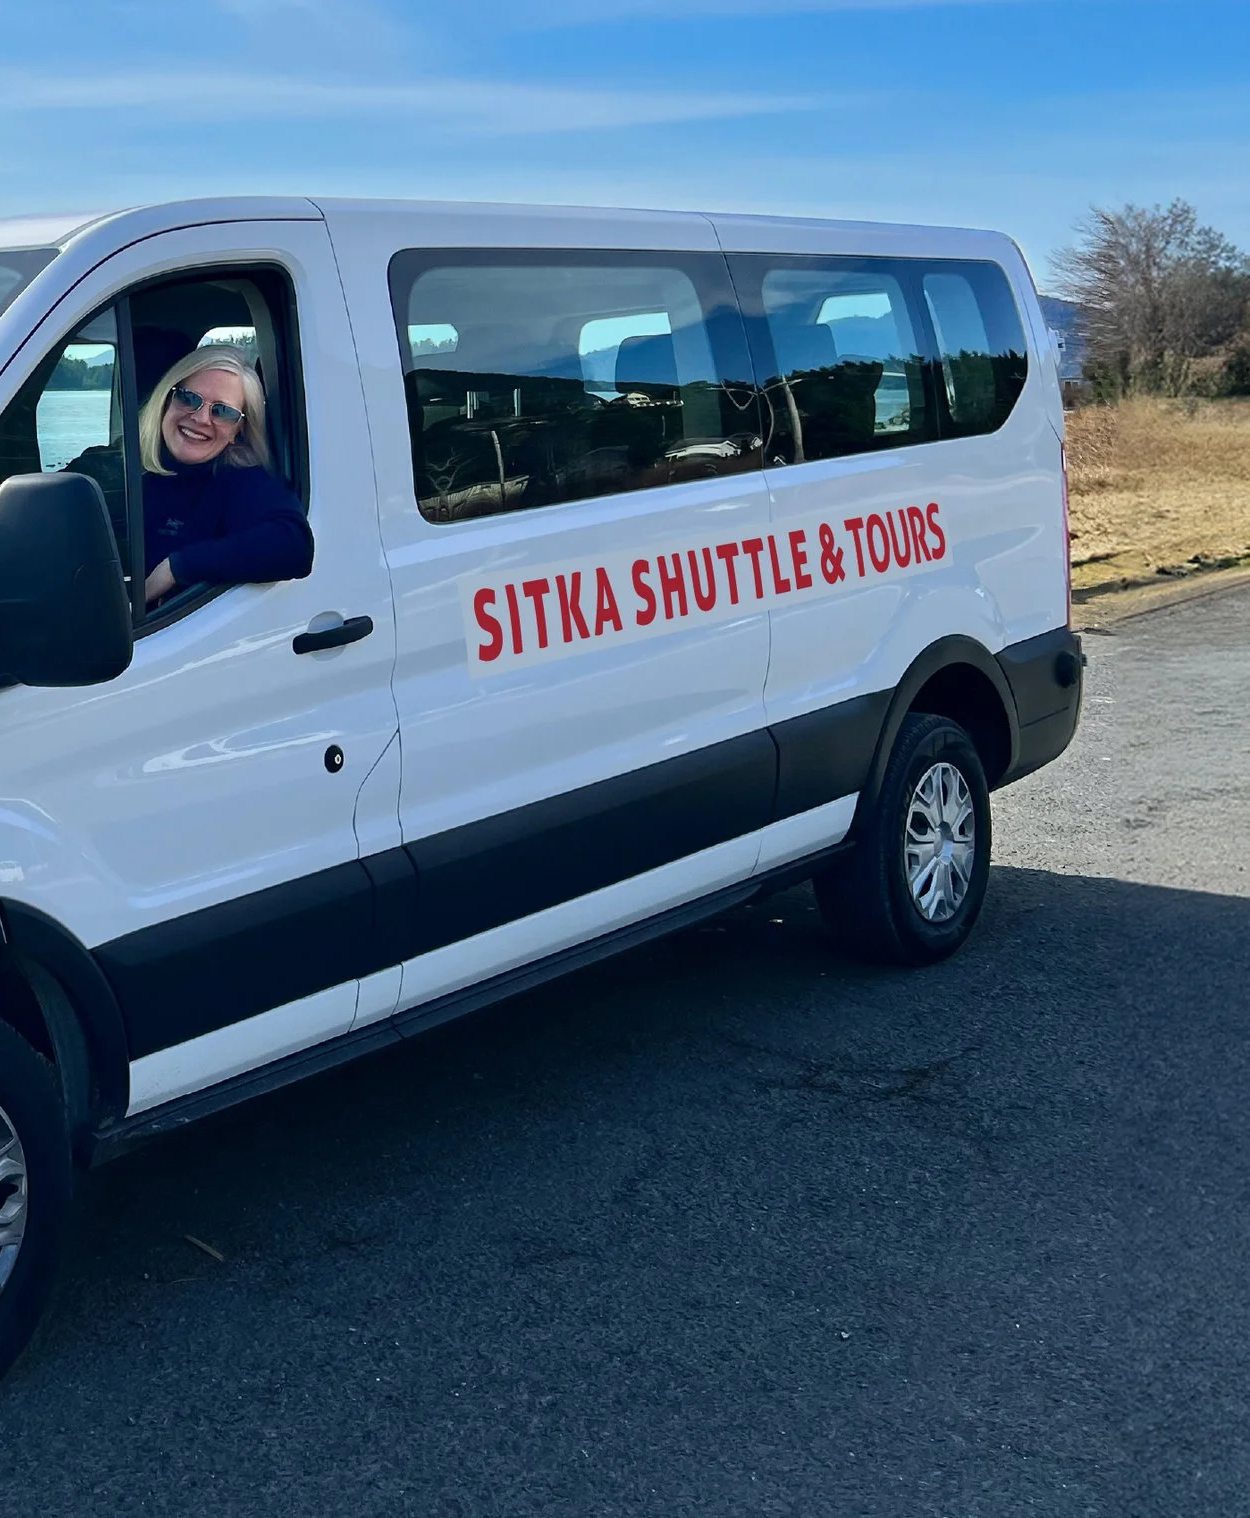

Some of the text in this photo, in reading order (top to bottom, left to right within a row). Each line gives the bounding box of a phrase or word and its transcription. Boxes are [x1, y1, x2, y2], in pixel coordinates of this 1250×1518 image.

[473, 502, 946, 662] SITKA SHUTTLE & TOURS
